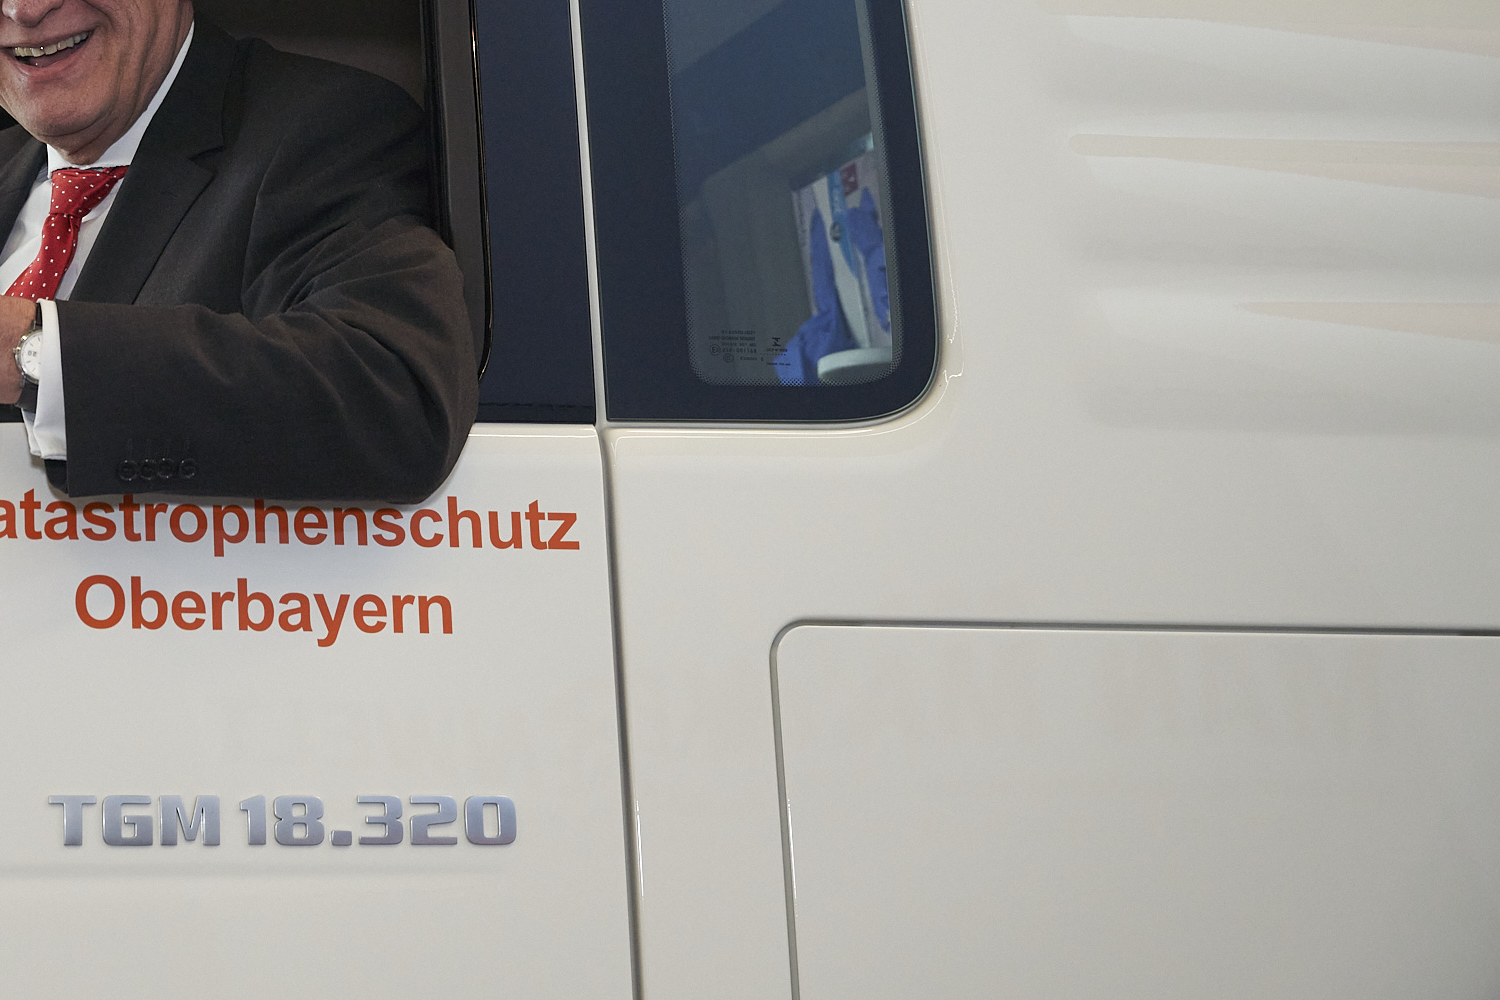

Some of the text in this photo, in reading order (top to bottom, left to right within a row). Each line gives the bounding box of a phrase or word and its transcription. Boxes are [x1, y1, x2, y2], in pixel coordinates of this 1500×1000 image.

[75, 574, 453, 647] Oberbayern
[48, 795, 517, 846] TGM 18.320
